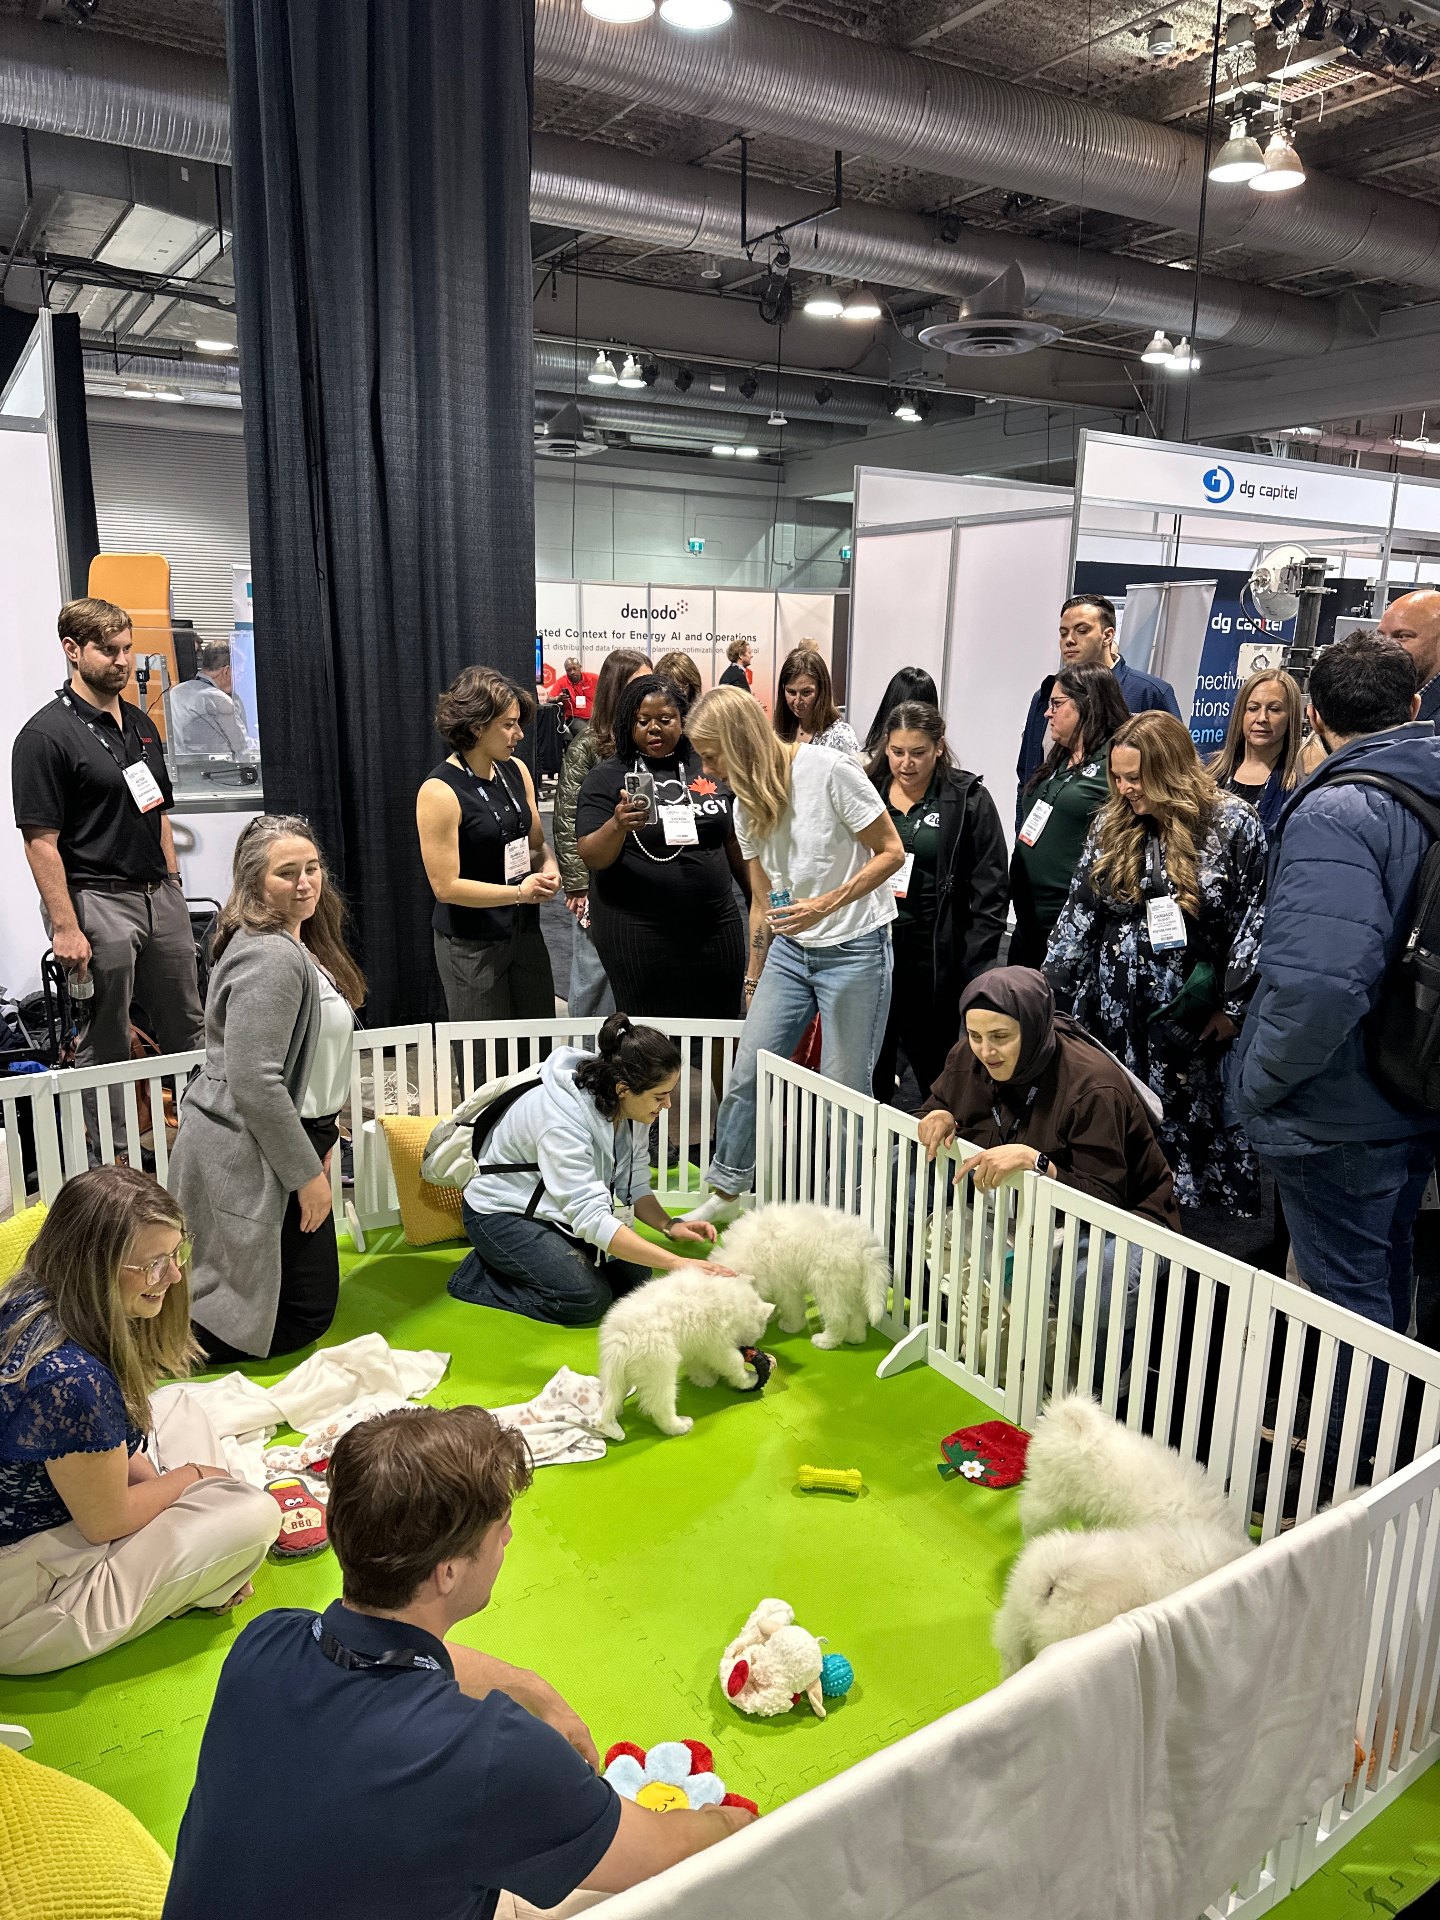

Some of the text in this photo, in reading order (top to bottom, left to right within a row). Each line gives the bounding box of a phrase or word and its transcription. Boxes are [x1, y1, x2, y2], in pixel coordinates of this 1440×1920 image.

[1240, 480, 1298, 500] dg capitel
[621, 603, 677, 620] denodo
[1211, 612, 1231, 633] dg
[536, 628, 757, 643] sted Context for Energy AI and Operations
[553, 643, 594, 652] distributed
[291, 1519, 312, 1529] BBQ
